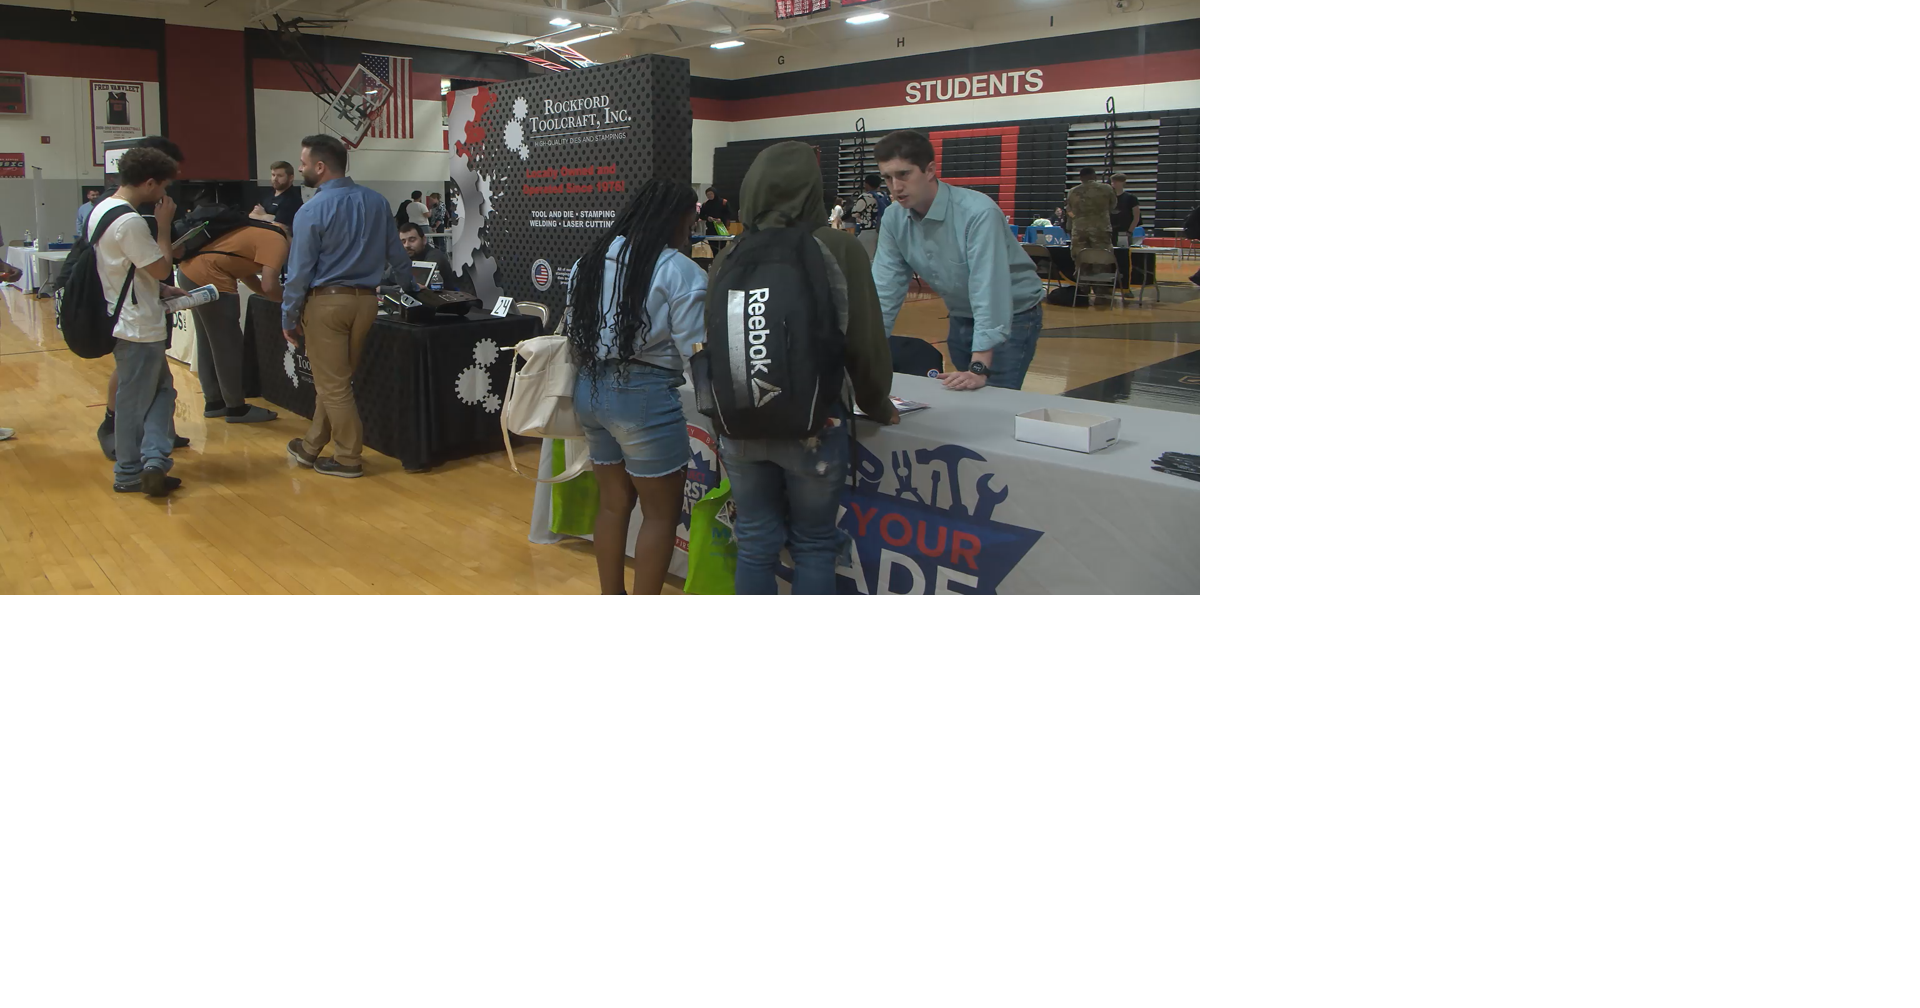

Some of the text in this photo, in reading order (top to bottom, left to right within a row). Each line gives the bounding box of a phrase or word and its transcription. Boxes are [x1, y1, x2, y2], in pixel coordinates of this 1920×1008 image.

[897, 37, 905, 47] H
[777, 55, 785, 65] G
[905, 68, 1043, 103] STUDENTS
[544, 95, 609, 115] ROCKFORD
[530, 107, 631, 132] TOOLCRAFT, INC.
[595, 132, 627, 142] STAMPINGS
[526, 163, 616, 180] Locally Owned and
[523, 183, 563, 196] Operated
[566, 182, 593, 194] Since
[531, 210, 616, 218] TOOL AND DIE STAMPING
[563, 220, 584, 228] LASER
[494, 299, 510, 315] 24
[747, 287, 772, 375] Reebok
[850, 501, 982, 570] YOUR
